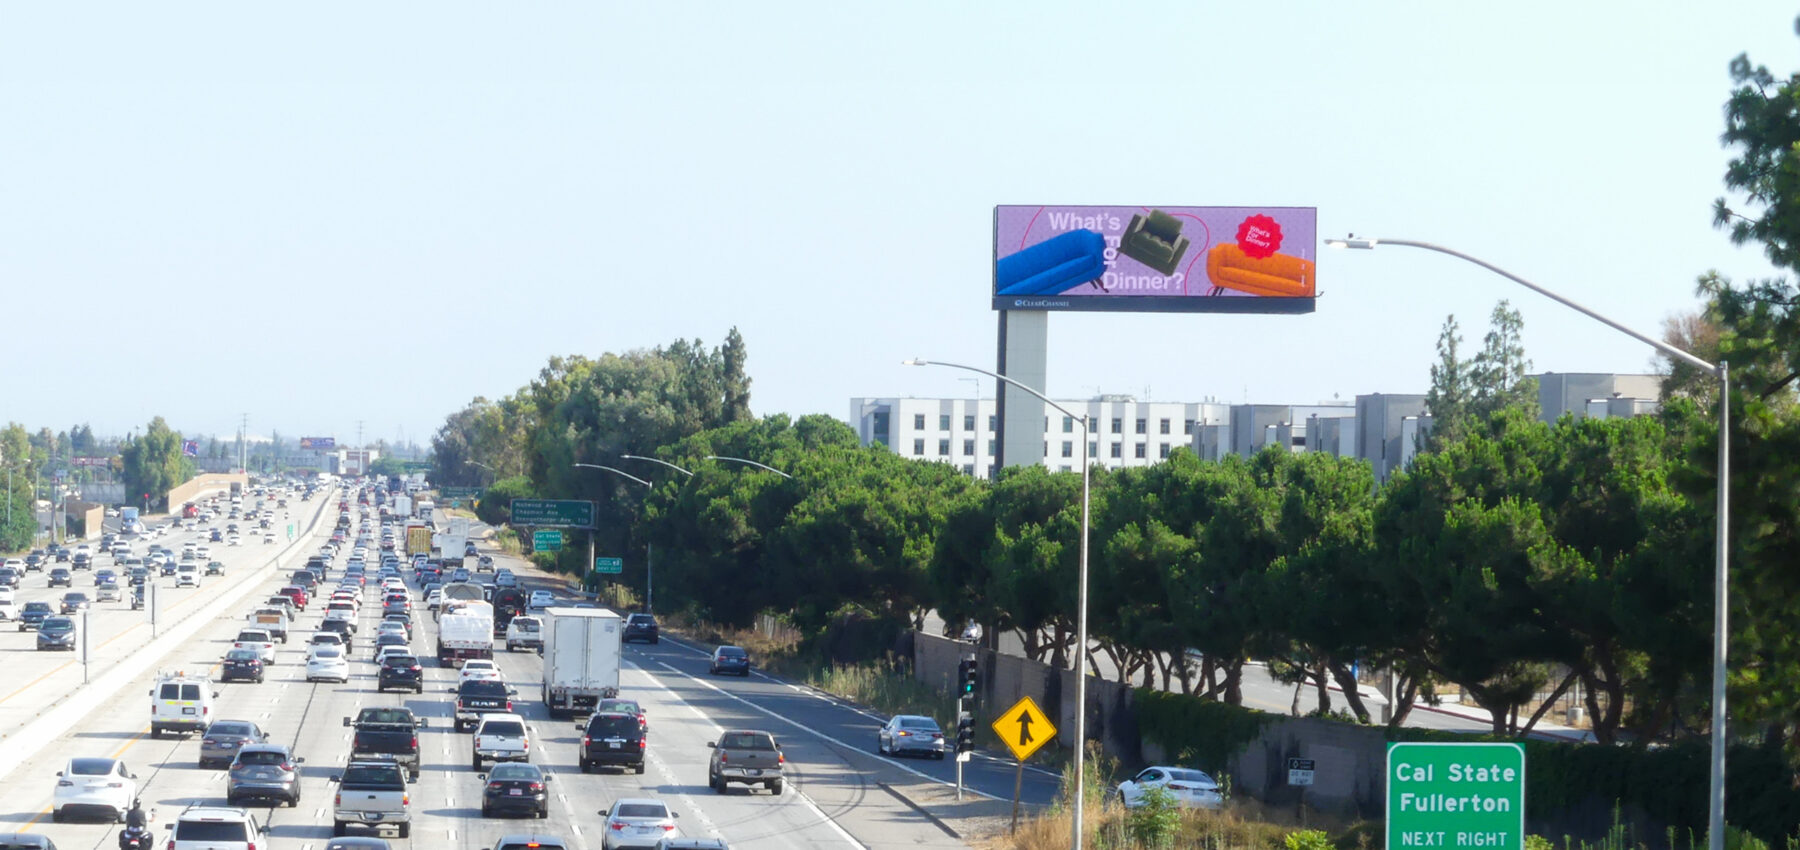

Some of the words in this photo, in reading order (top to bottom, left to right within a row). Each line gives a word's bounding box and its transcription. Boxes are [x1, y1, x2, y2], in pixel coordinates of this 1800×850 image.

[1048, 212, 1122, 231] What's
[1249, 225, 1270, 238] What's
[1103, 234, 1121, 268] For
[1103, 272, 1185, 290] Dinner?
[1396, 763, 1433, 782] Cal
[1448, 763, 1515, 782] State
[1400, 793, 1510, 812] Fullerton
[1402, 832, 1445, 846] NEXT
[1457, 832, 1507, 846] RIGHT
